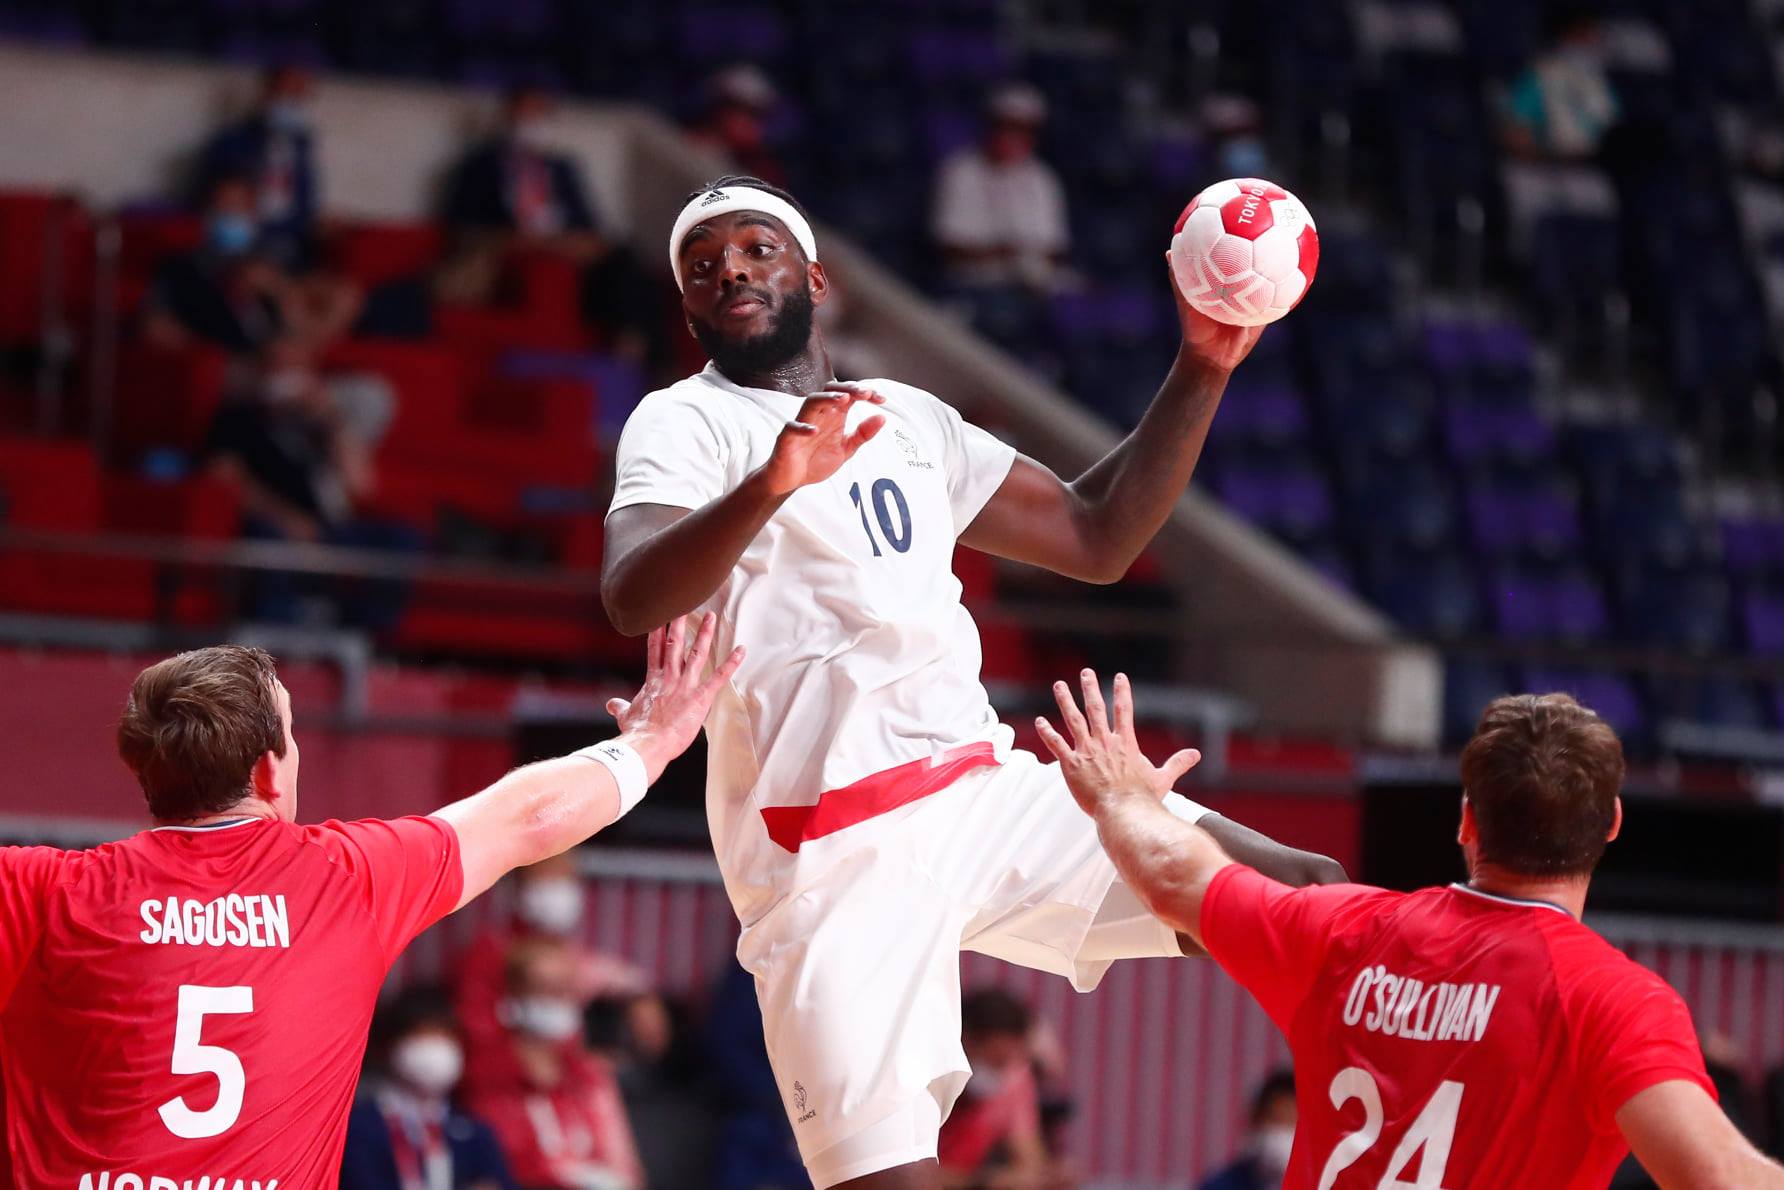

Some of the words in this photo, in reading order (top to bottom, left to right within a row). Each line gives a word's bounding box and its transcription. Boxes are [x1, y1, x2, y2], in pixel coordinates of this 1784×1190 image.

[701, 195, 730, 207] adidas
[1238, 188, 1265, 224] TOKYO
[907, 460, 934, 469] FRANCE
[849, 478, 912, 556] 10
[140, 893, 290, 948] SAGOSEN
[1342, 964, 1501, 1042] O'SULLIVAN
[157, 984, 254, 1139] 5
[798, 1109, 816, 1124] FRANCE
[1317, 1066, 1465, 1190] 24
